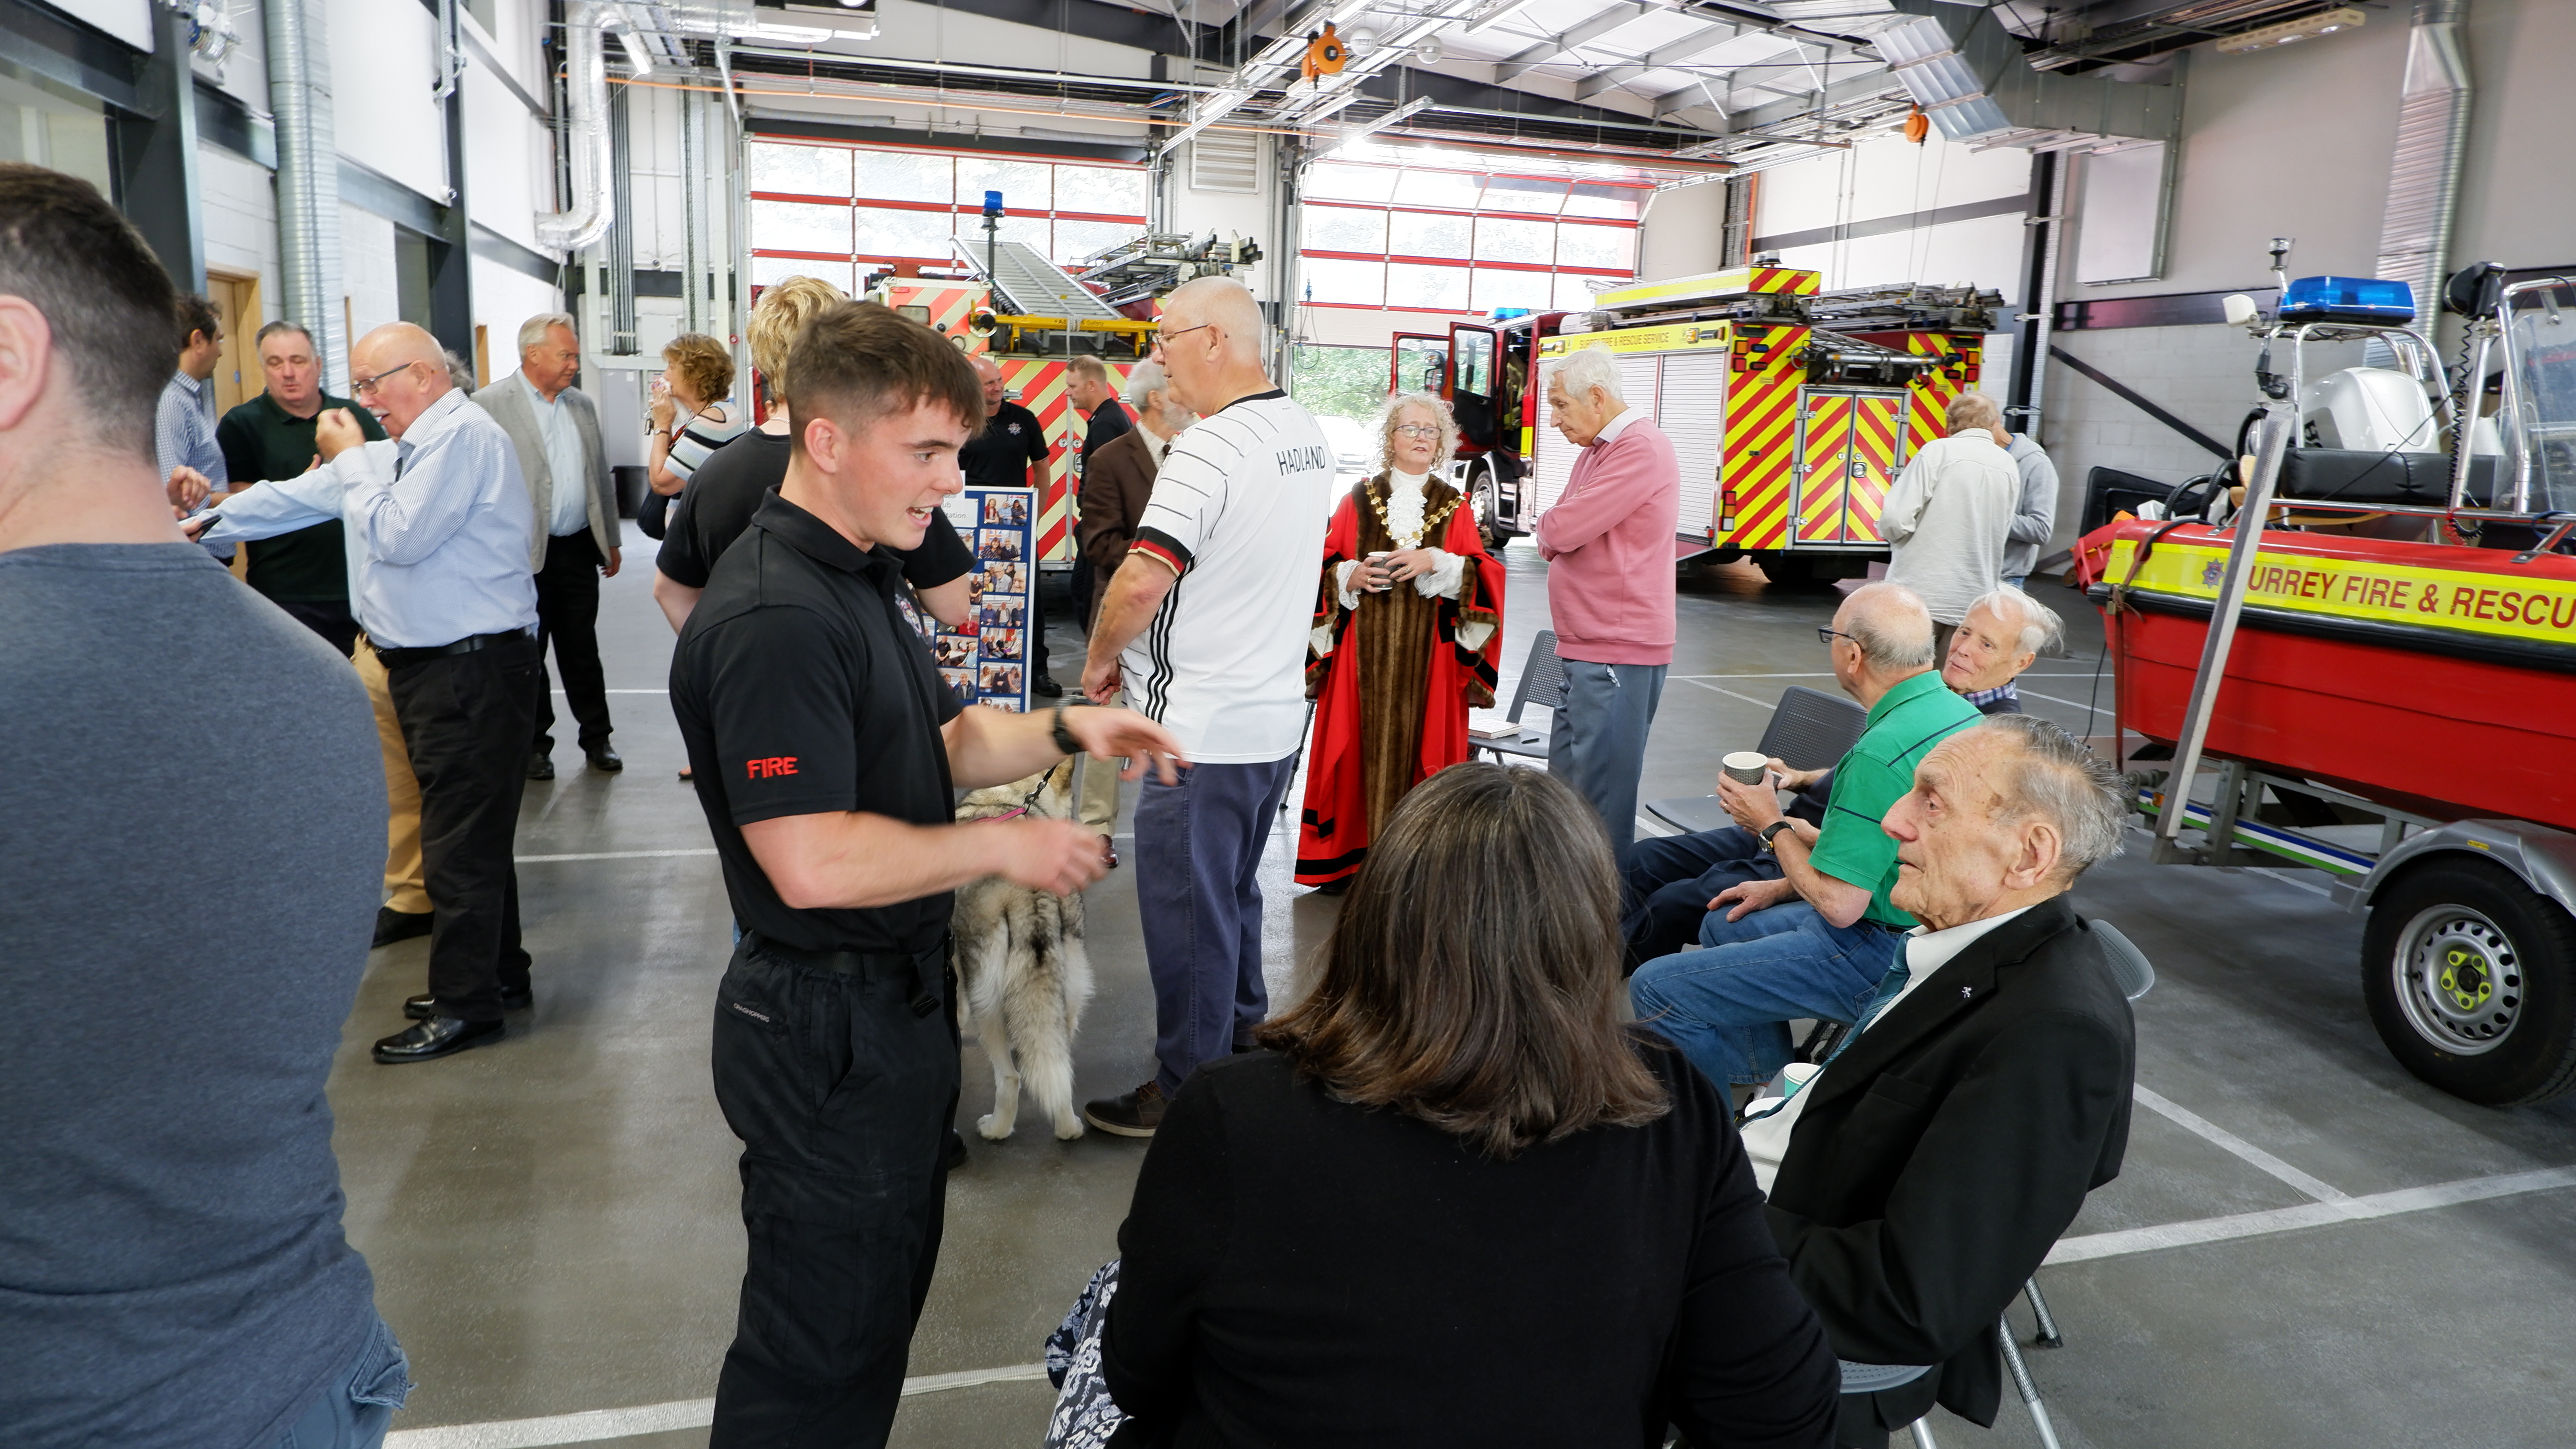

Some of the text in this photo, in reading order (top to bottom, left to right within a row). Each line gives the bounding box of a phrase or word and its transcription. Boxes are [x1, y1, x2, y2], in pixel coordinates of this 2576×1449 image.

[1619, 334, 1642, 346] RESCUE
[1643, 332, 1669, 344] SERVICE
[1276, 446, 1326, 476] HADLAND
[2248, 565, 2576, 629] URREY FIRE & RESCU
[746, 757, 799, 779] FIRE
